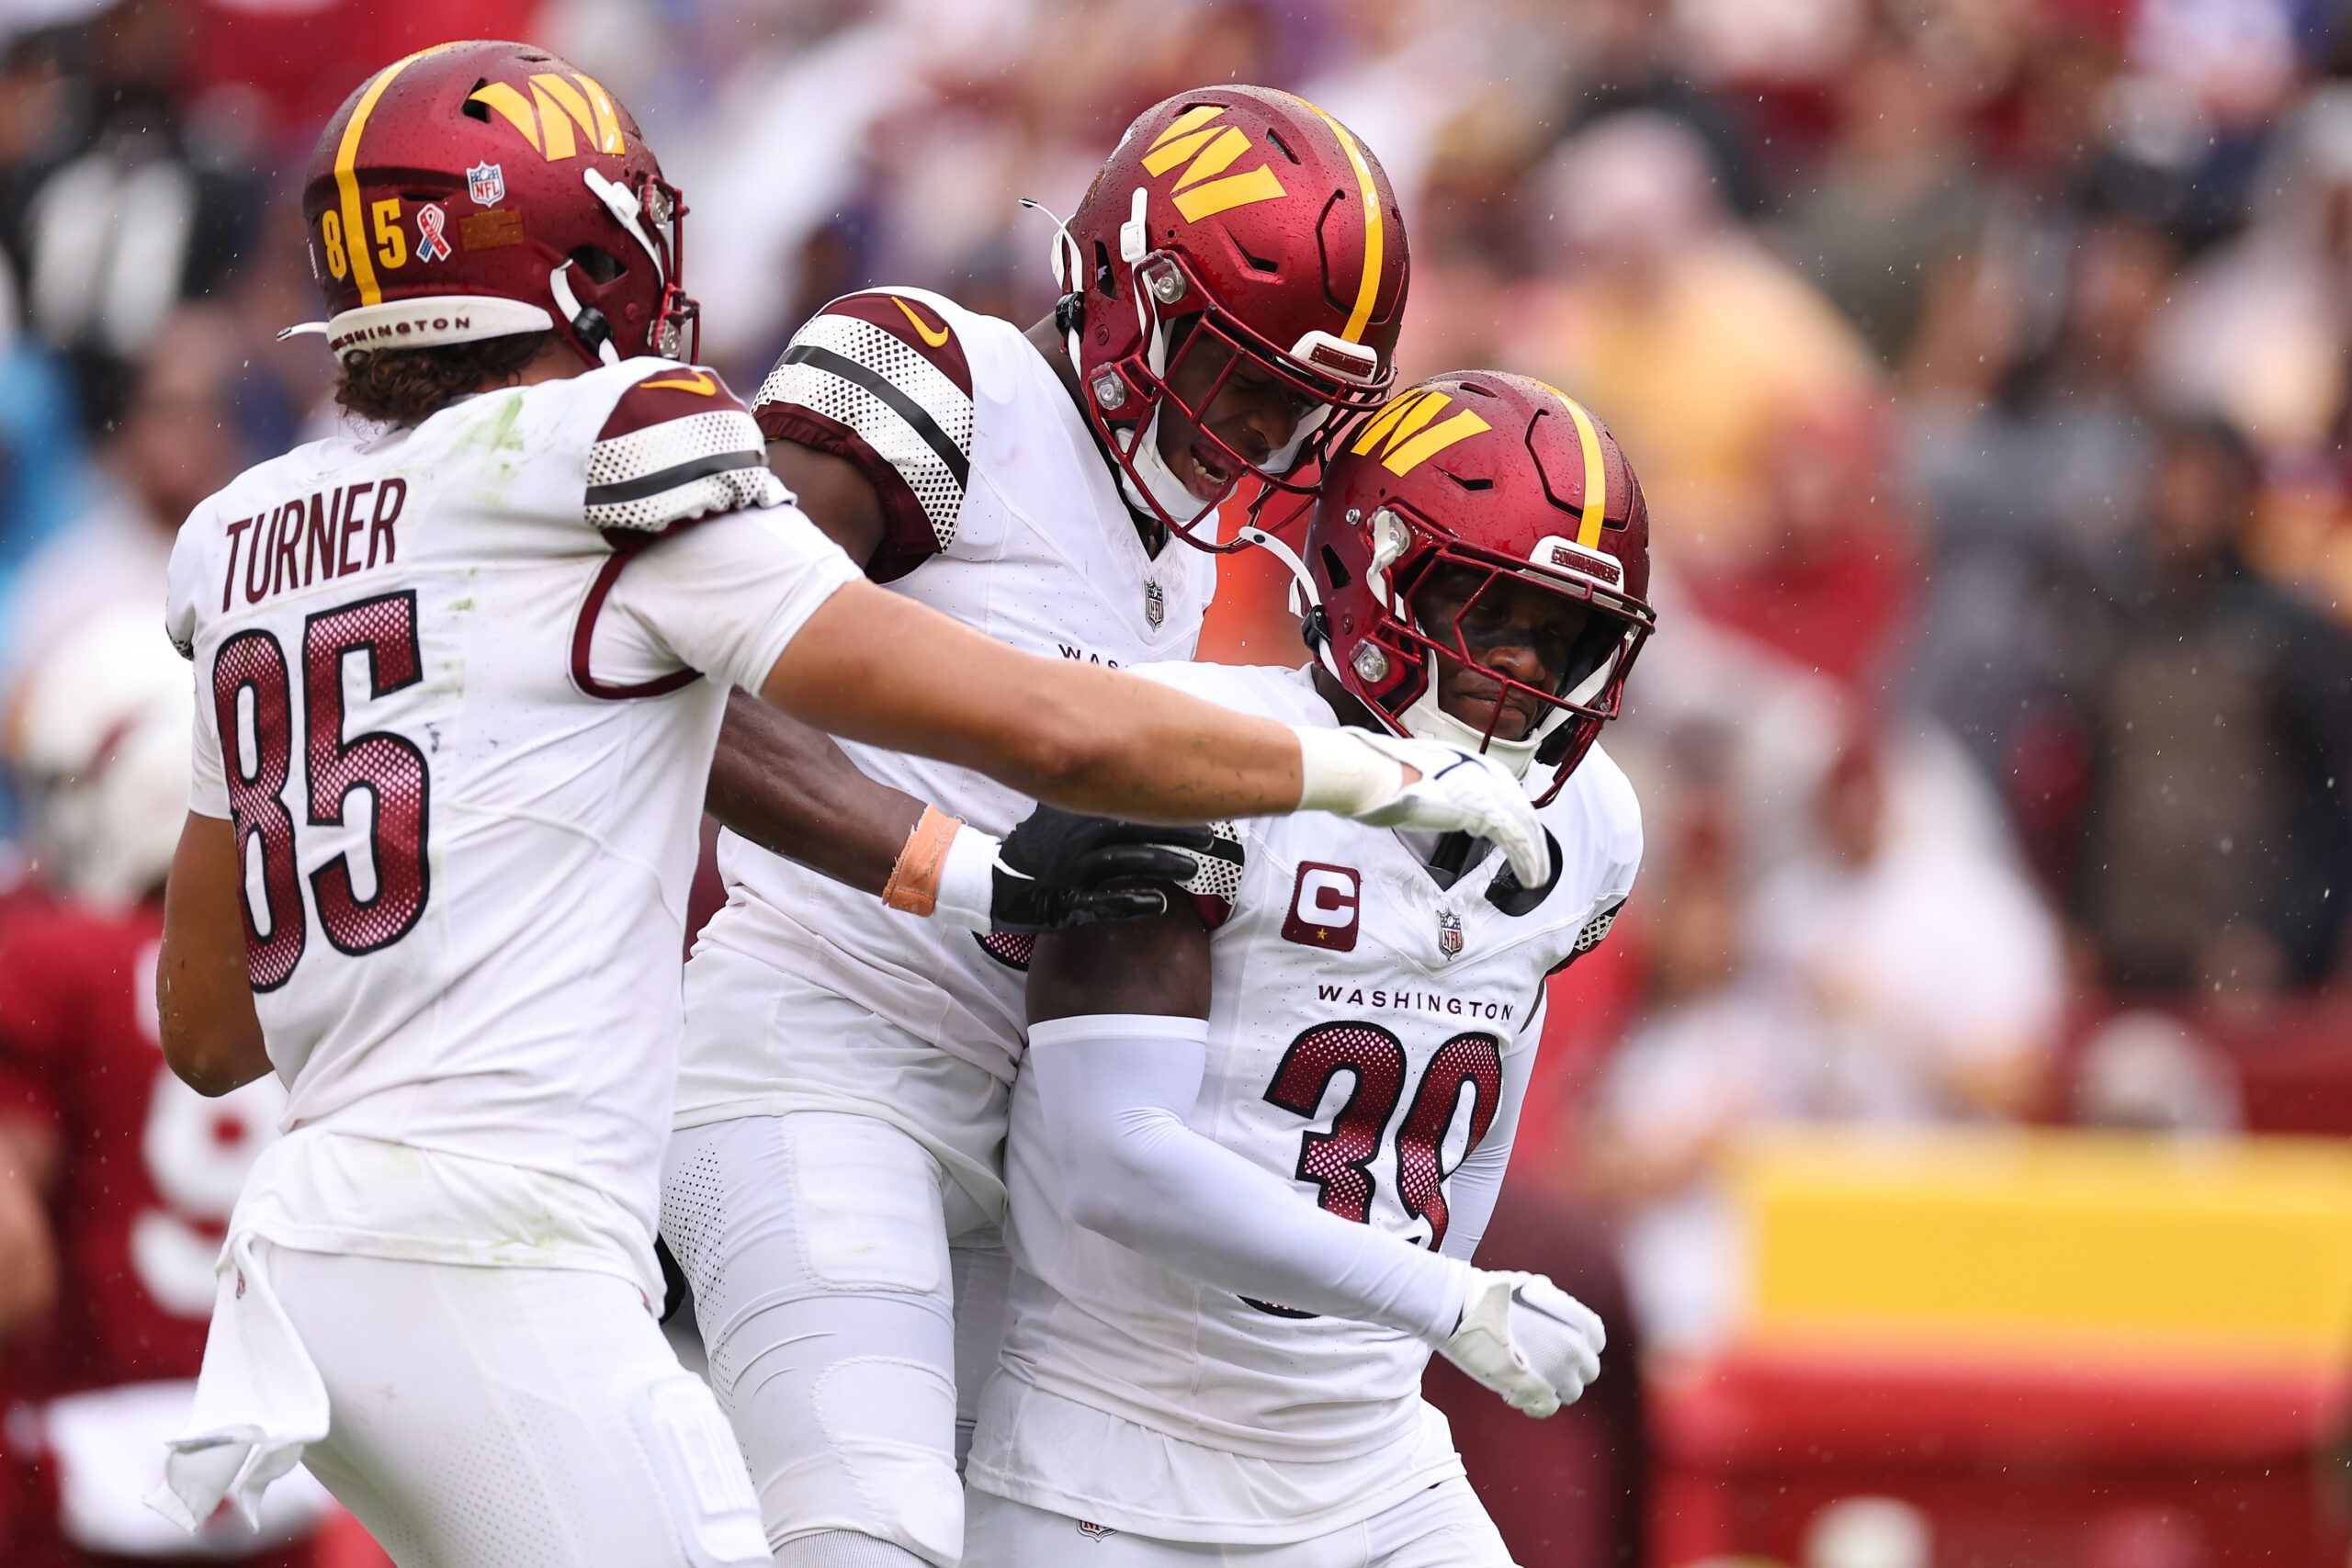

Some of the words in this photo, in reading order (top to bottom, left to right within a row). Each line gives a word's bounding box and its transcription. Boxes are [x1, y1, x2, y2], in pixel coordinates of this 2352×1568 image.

[221, 477, 408, 614] TURNER
[212, 589, 430, 994] 85
[1296, 868, 1356, 929] C
[1317, 985, 1514, 1021] WASHINGTON
